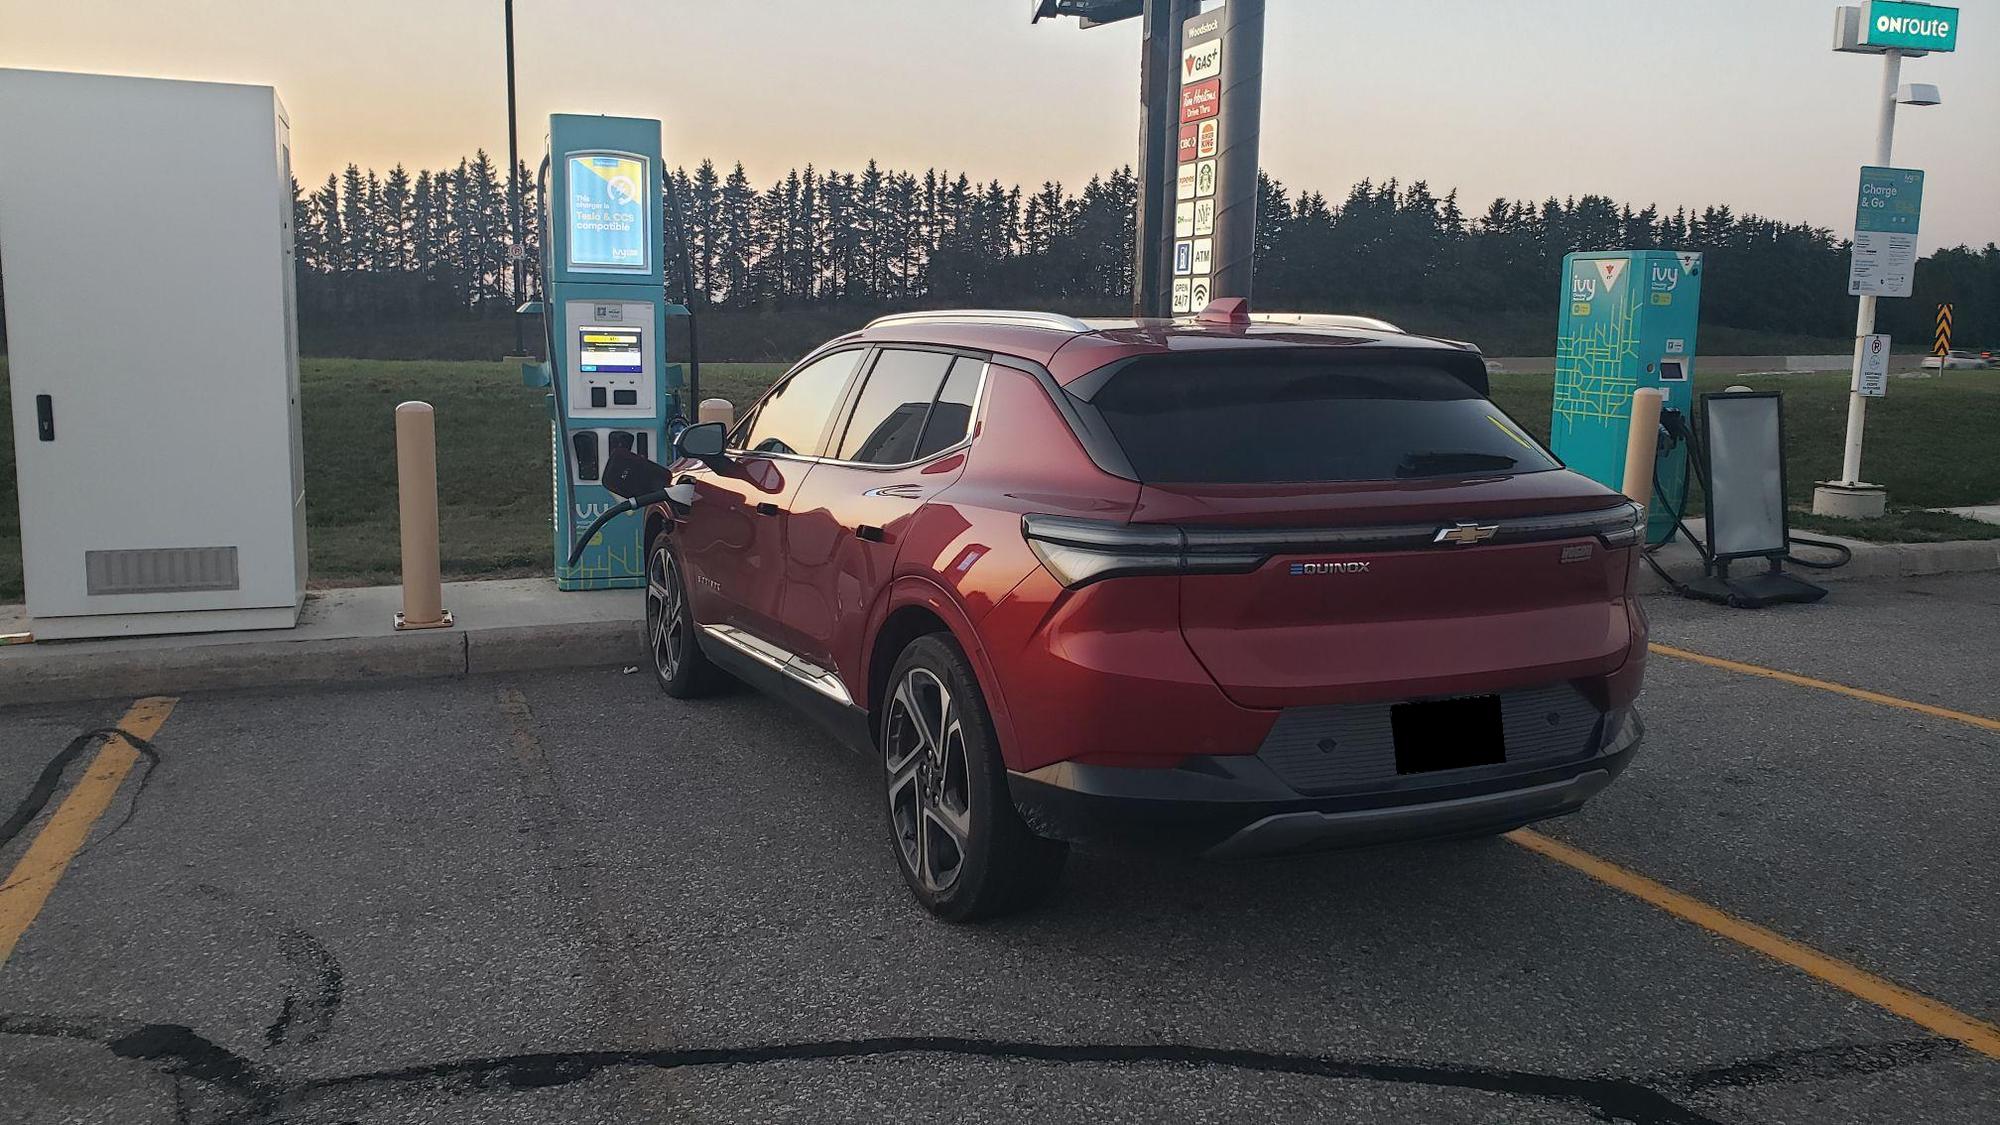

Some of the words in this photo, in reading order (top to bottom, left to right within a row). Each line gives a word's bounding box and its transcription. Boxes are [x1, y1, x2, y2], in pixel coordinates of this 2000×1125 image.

[1188, 20, 1218, 38] Woodstock
[1877, 15, 1949, 37] ONroute
[1862, 183, 1898, 197] Charge
[1861, 197, 1868, 207] &
[1871, 197, 1885, 208] Go
[613, 212, 635, 222] CCS
[576, 221, 631, 232] compatible
[1195, 250, 1210, 262] ATM
[1652, 262, 1678, 291] ivy
[1175, 284, 1188, 292] OPEN
[1573, 274, 1596, 301] ivy
[1174, 295, 1188, 306] 24/7
[1290, 562, 1370, 575] EQUINOX
